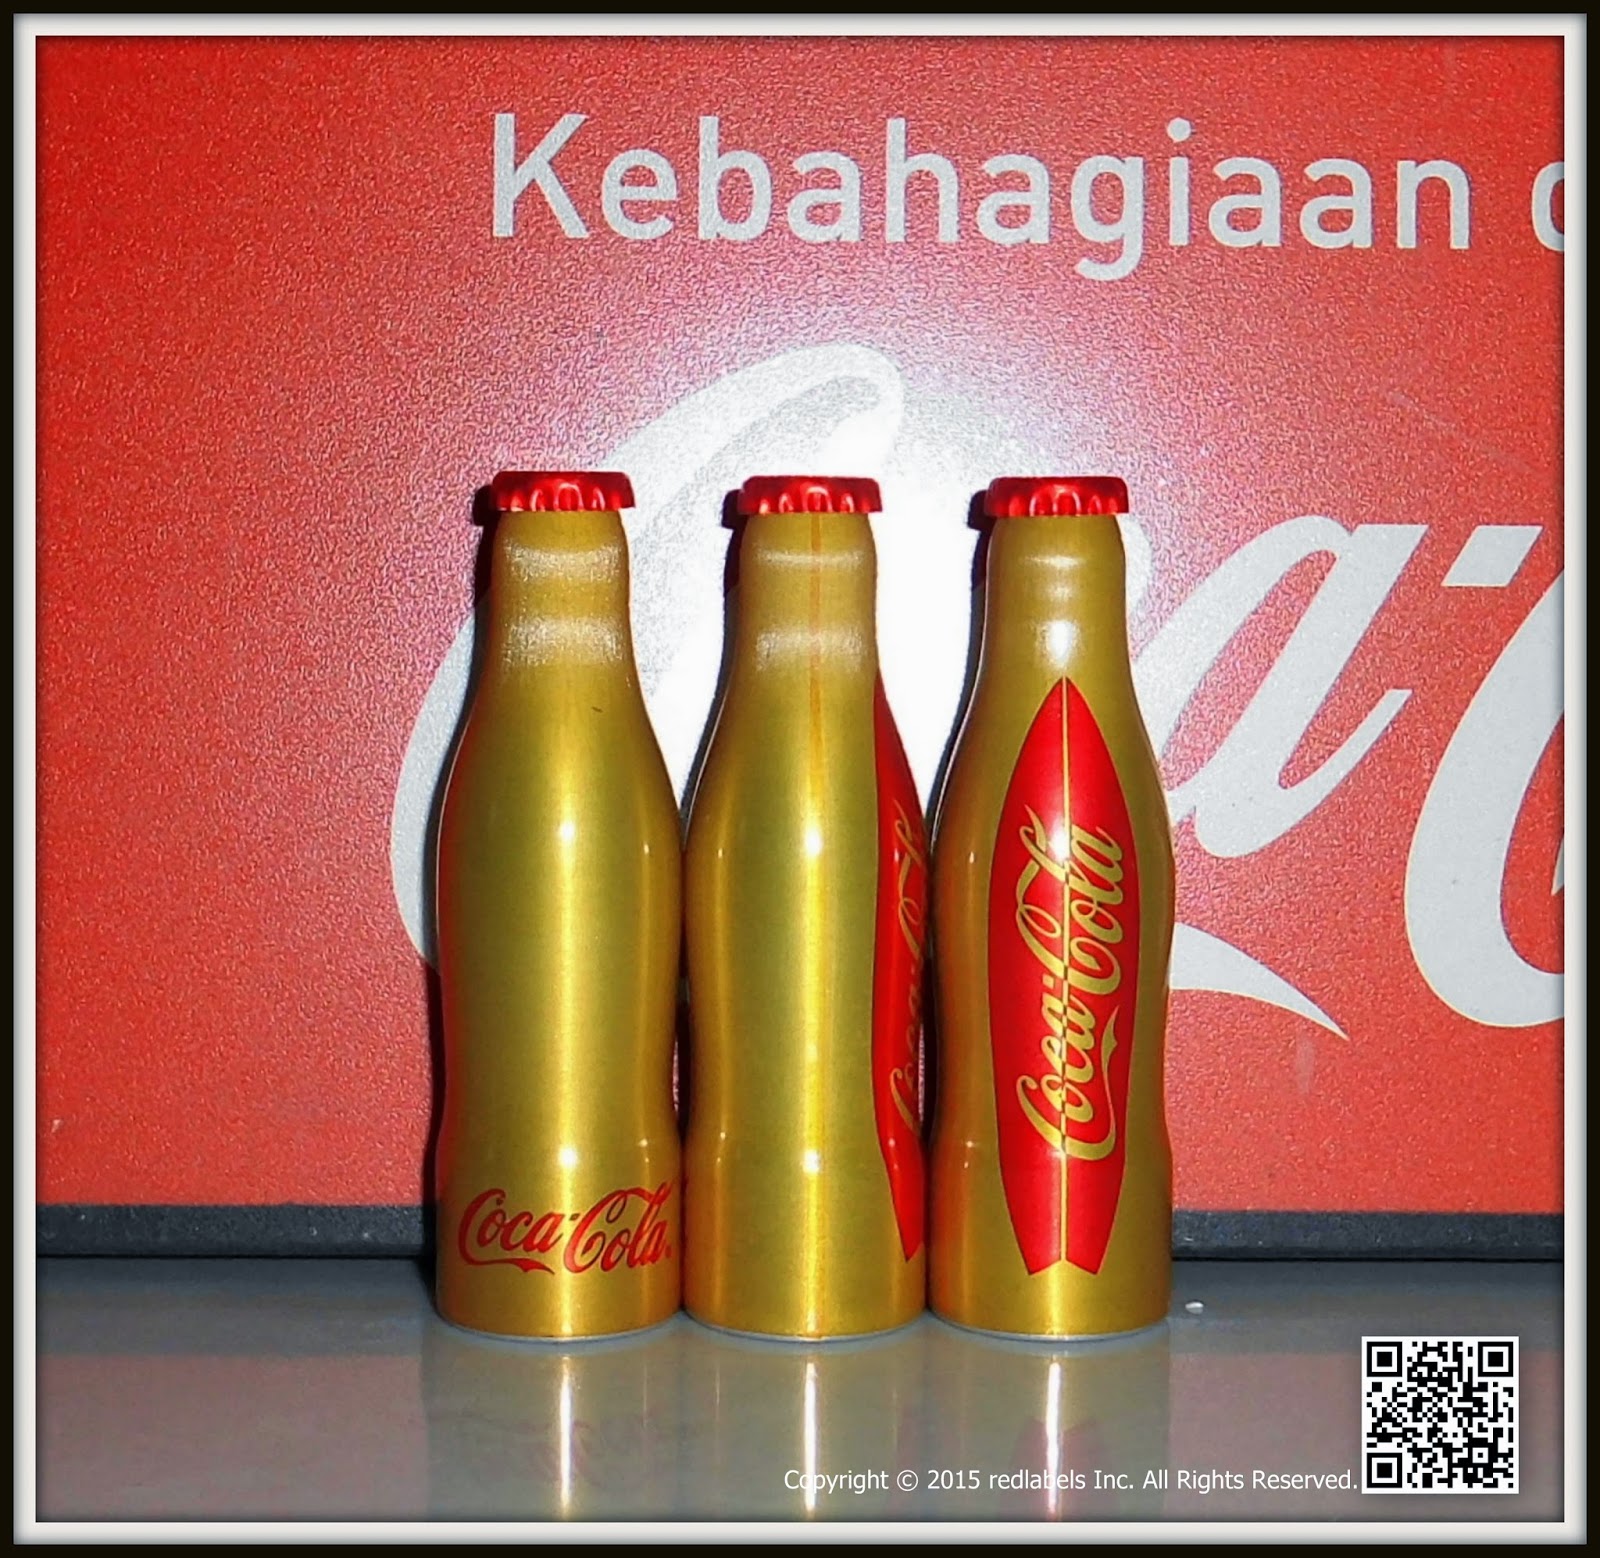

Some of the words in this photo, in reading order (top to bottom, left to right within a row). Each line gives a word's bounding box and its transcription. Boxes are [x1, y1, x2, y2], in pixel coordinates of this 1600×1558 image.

[491, 112, 1471, 281] Kebahagiaan
[1016, 804, 1124, 1161] Coca-Cola
[457, 1181, 673, 1275] Coca-Cola
